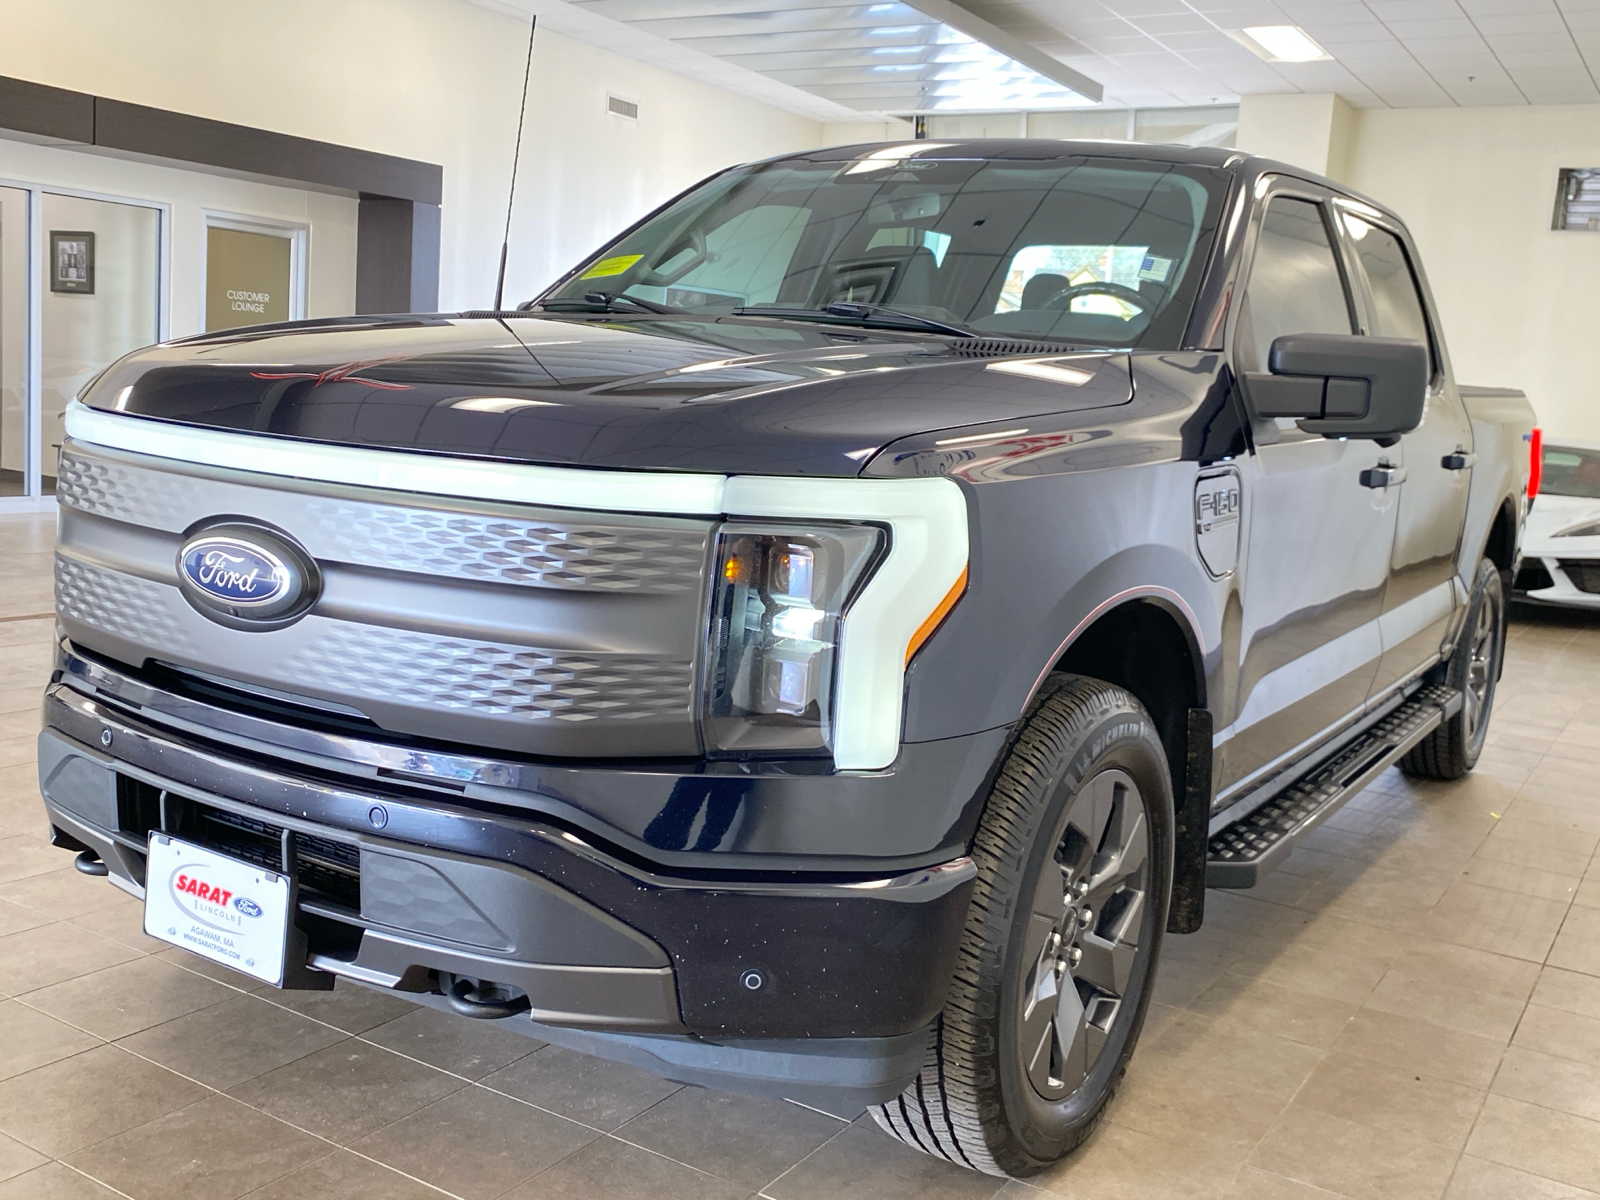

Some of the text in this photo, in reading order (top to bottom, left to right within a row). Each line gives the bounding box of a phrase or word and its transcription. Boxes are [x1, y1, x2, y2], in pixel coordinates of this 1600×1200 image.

[227, 290, 270, 302] CUSTOMER
[232, 302, 265, 313] LOUNGE
[199, 550, 259, 593] Ford
[1092, 722, 1140, 760] MICHELIN
[176, 873, 233, 907] SARAT
[200, 901, 236, 922] LINCOLN
[236, 899, 259, 917] Ford
[183, 932, 241, 960] WWW.SARATFORD.COM
[191, 925, 235, 948] AGAWAM, MA
